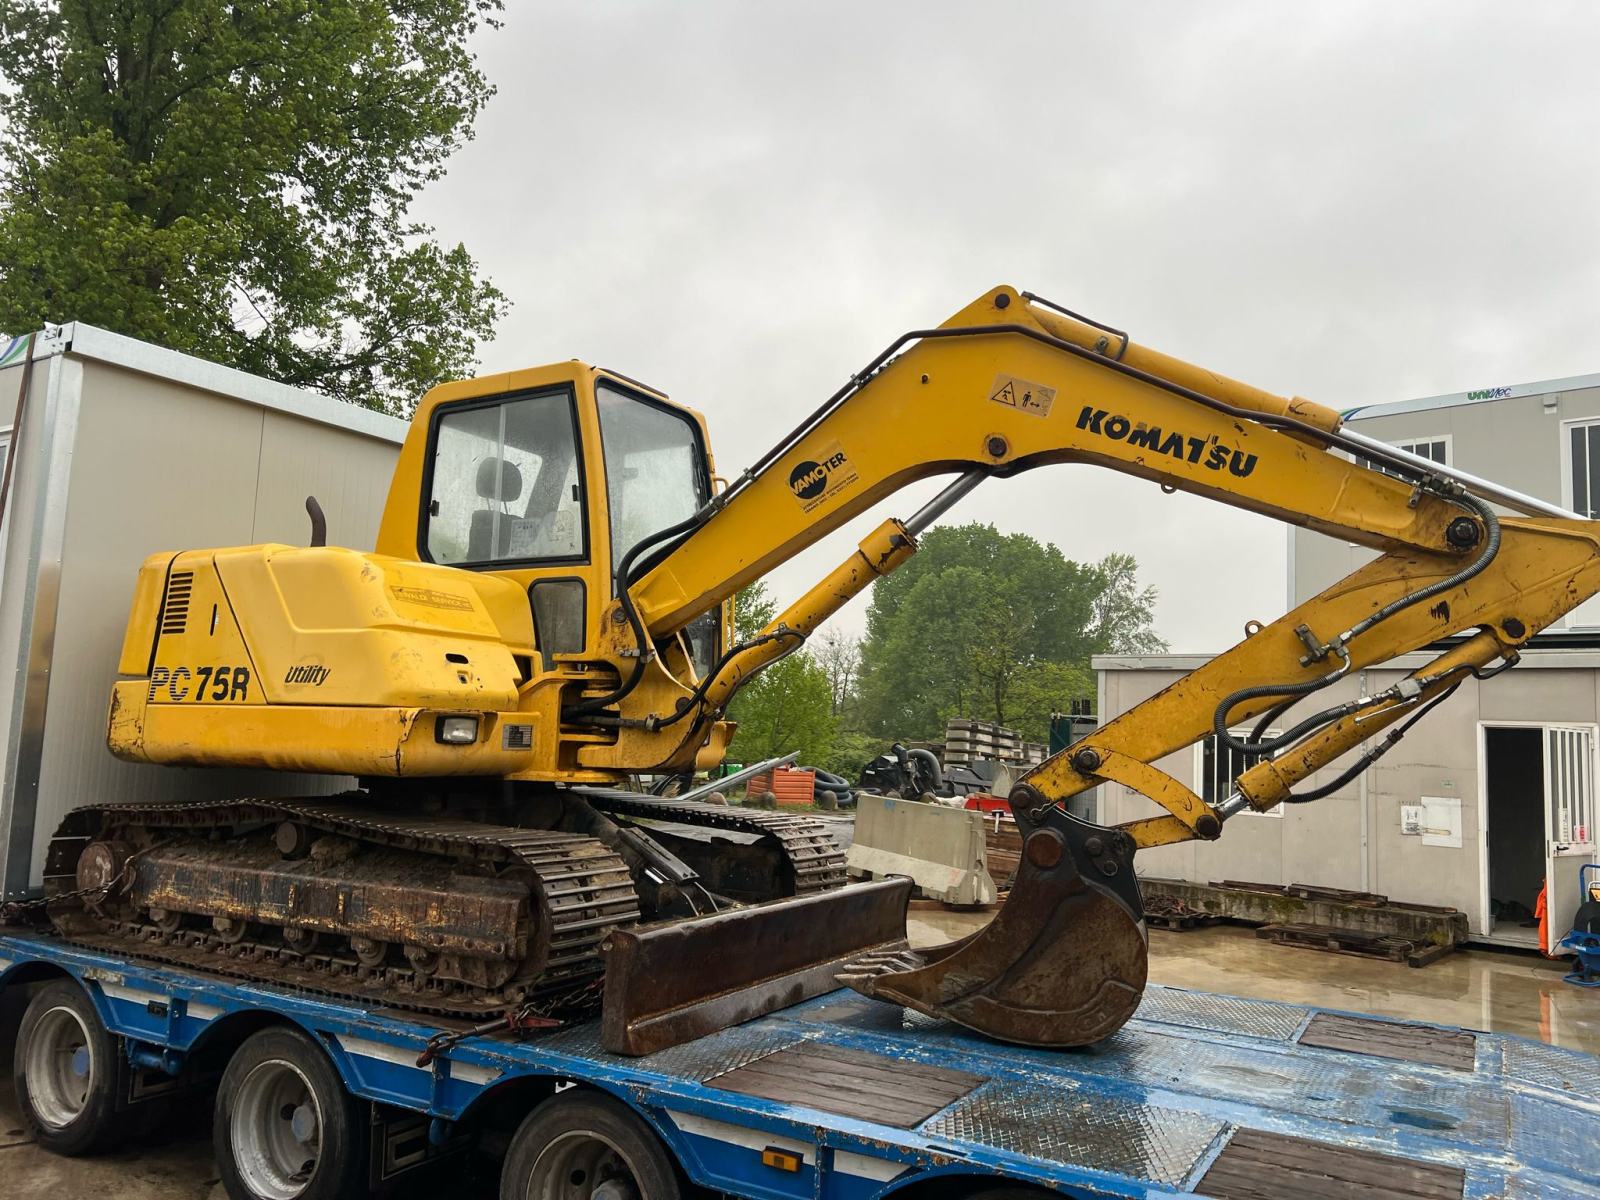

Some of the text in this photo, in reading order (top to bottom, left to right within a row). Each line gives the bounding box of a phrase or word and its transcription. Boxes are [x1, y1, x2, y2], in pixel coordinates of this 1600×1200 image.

[1075, 405, 1259, 478] KOMATSU
[789, 452, 847, 495] VAMOTER
[284, 664, 331, 687] Utility
